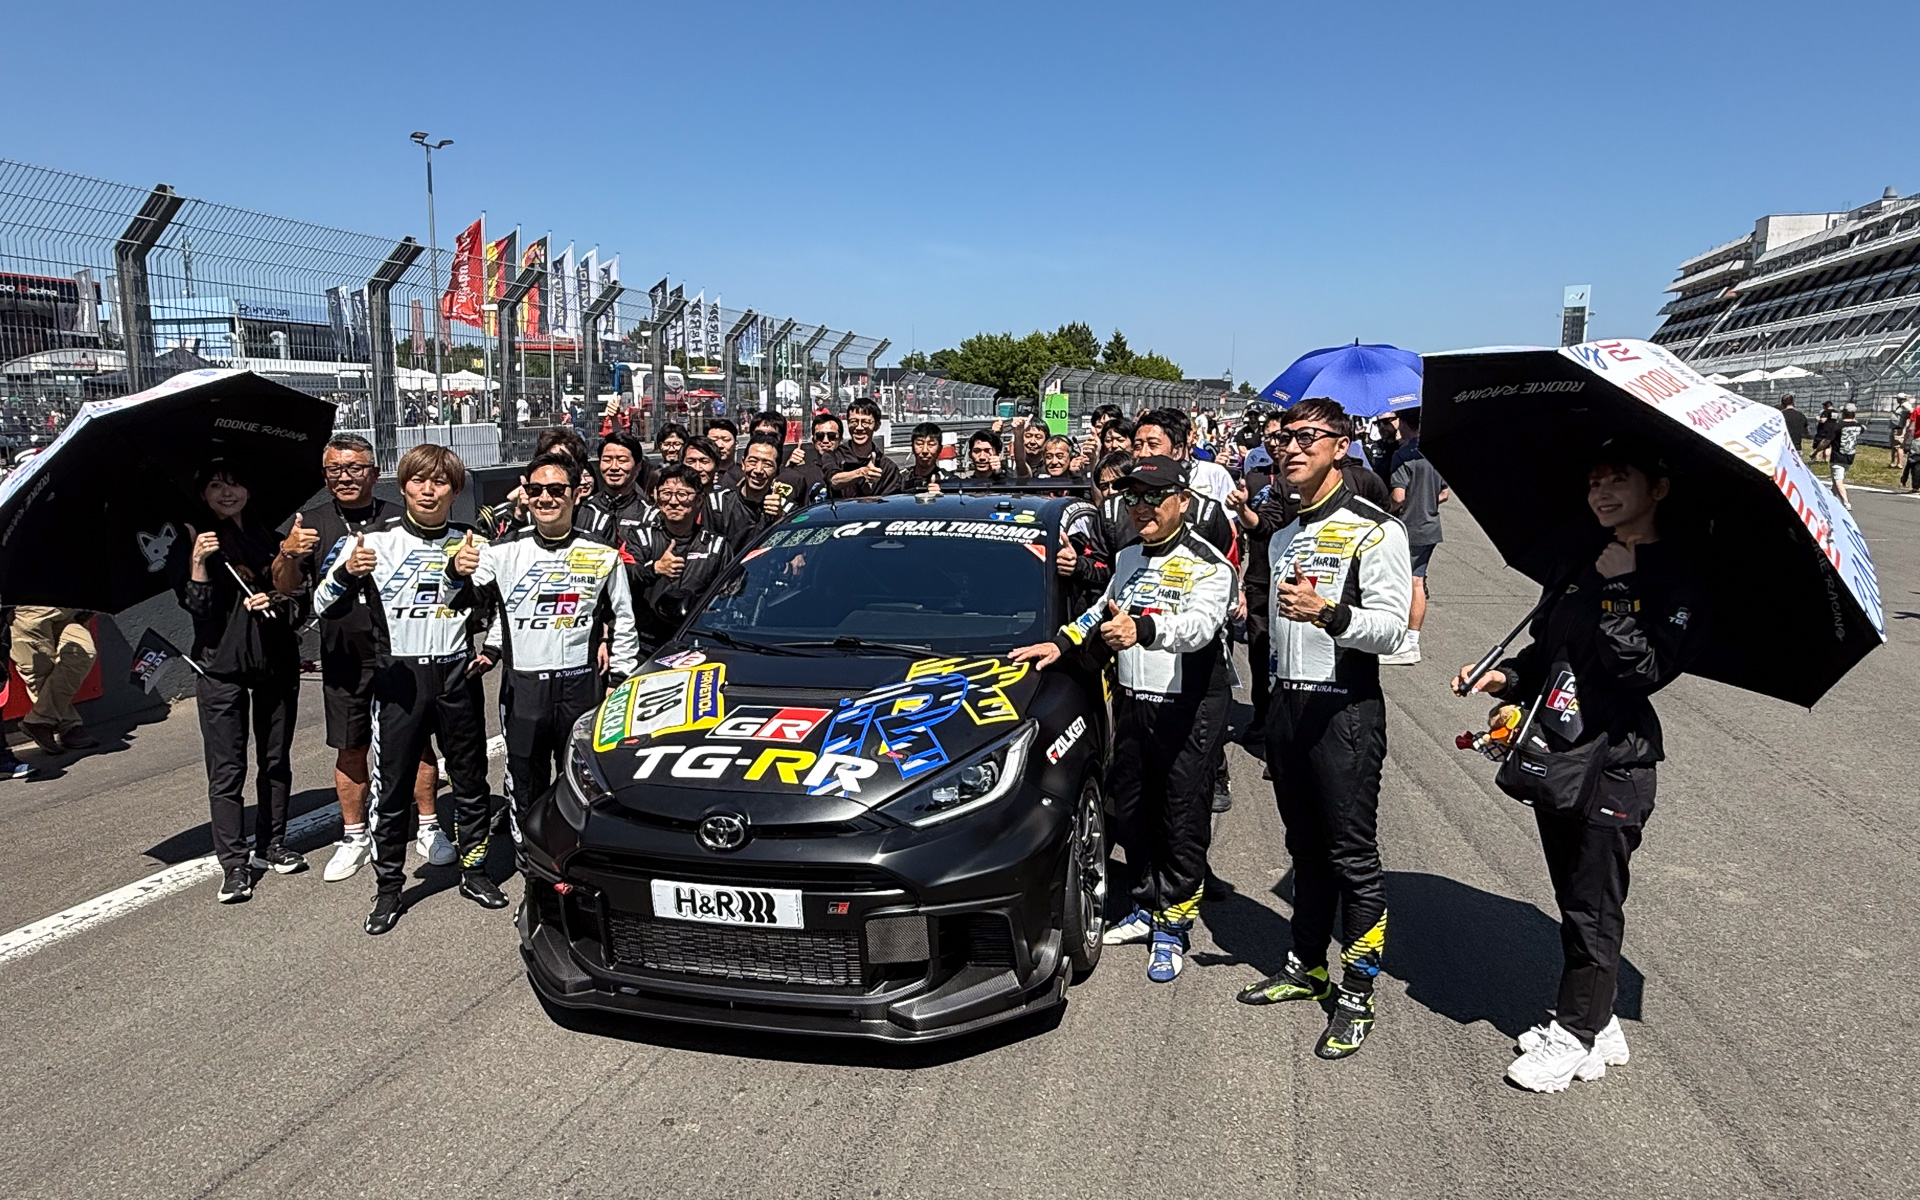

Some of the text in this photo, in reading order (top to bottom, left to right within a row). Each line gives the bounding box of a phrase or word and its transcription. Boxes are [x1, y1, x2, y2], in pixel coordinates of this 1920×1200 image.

[252, 305, 291, 317] HYUNDAI
[1520, 381, 1586, 394] ROOKIE
[1045, 410, 1067, 419] END
[213, 417, 308, 442] ROOKIE RACING
[885, 520, 1041, 539] GRAN TURISMO
[974, 534, 1034, 544] SIMULATOR
[535, 601, 577, 615] GR
[515, 616, 590, 630] TG-RR
[636, 681, 686, 722] 109
[698, 670, 714, 716] RAVENOL
[600, 695, 629, 744] DEKRA
[714, 716, 813, 740] GR
[1046, 715, 1087, 765] FALKEN
[632, 745, 880, 793] TG-RR
[675, 886, 737, 919] H&R
